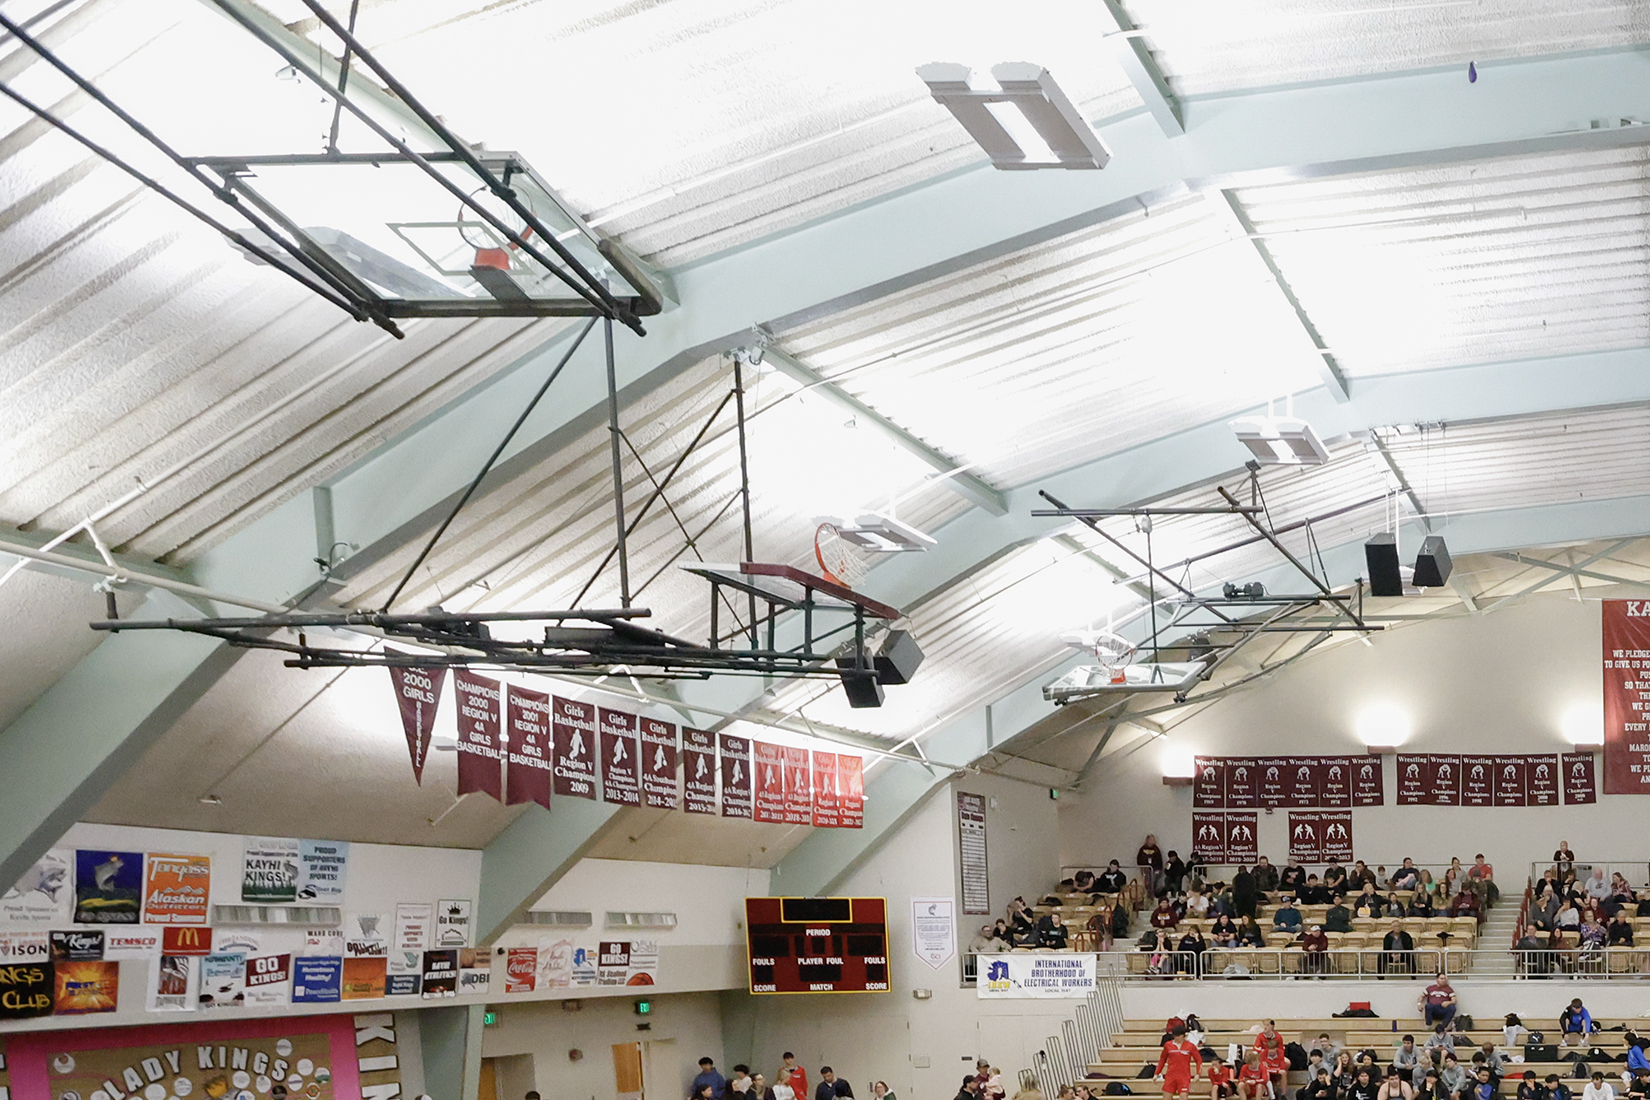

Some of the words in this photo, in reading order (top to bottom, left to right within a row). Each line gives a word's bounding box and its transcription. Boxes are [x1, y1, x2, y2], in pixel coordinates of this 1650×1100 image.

[403, 673, 431, 689] 2000
[403, 686, 434, 703] GIRLS
[457, 680, 500, 700] CHAMPIONS
[469, 696, 488, 709] 2000
[510, 695, 549, 713] CHAMPIONS
[462, 705, 489, 721] REGION
[491, 713, 497, 722] V
[522, 710, 538, 721] 2001
[564, 704, 584, 717] Girls
[475, 721, 485, 732] 4A
[554, 713, 594, 731] Basketball
[609, 714, 627, 726] Girls
[515, 720, 539, 733] REGION
[541, 726, 547, 735] V
[601, 724, 636, 739] Basketball
[470, 732, 491, 745] GIRLS
[526, 734, 535, 744] 4A
[522, 745, 541, 757] GIRLS
[560, 756, 585, 770] Region
[587, 762, 593, 771] V
[570, 782, 589, 793] 2009
[606, 788, 639, 802] 2013-2014
[149, 857, 209, 882] Tongass
[246, 860, 281, 869] KAYHI
[245, 871, 286, 881] KINGS!
[150, 892, 205, 904] Alaskan
[439, 916, 447, 924] Go
[610, 944, 621, 954] GO
[256, 958, 278, 972] GO
[1035, 960, 1082, 968] INTERNATIONAL
[250, 971, 286, 984] KINGS!
[472, 974, 490, 983] DBI
[1024, 979, 1058, 987] ELECTRICAL
[2, 992, 50, 1008] CLUB
[198, 1046, 287, 1081] KINGS
